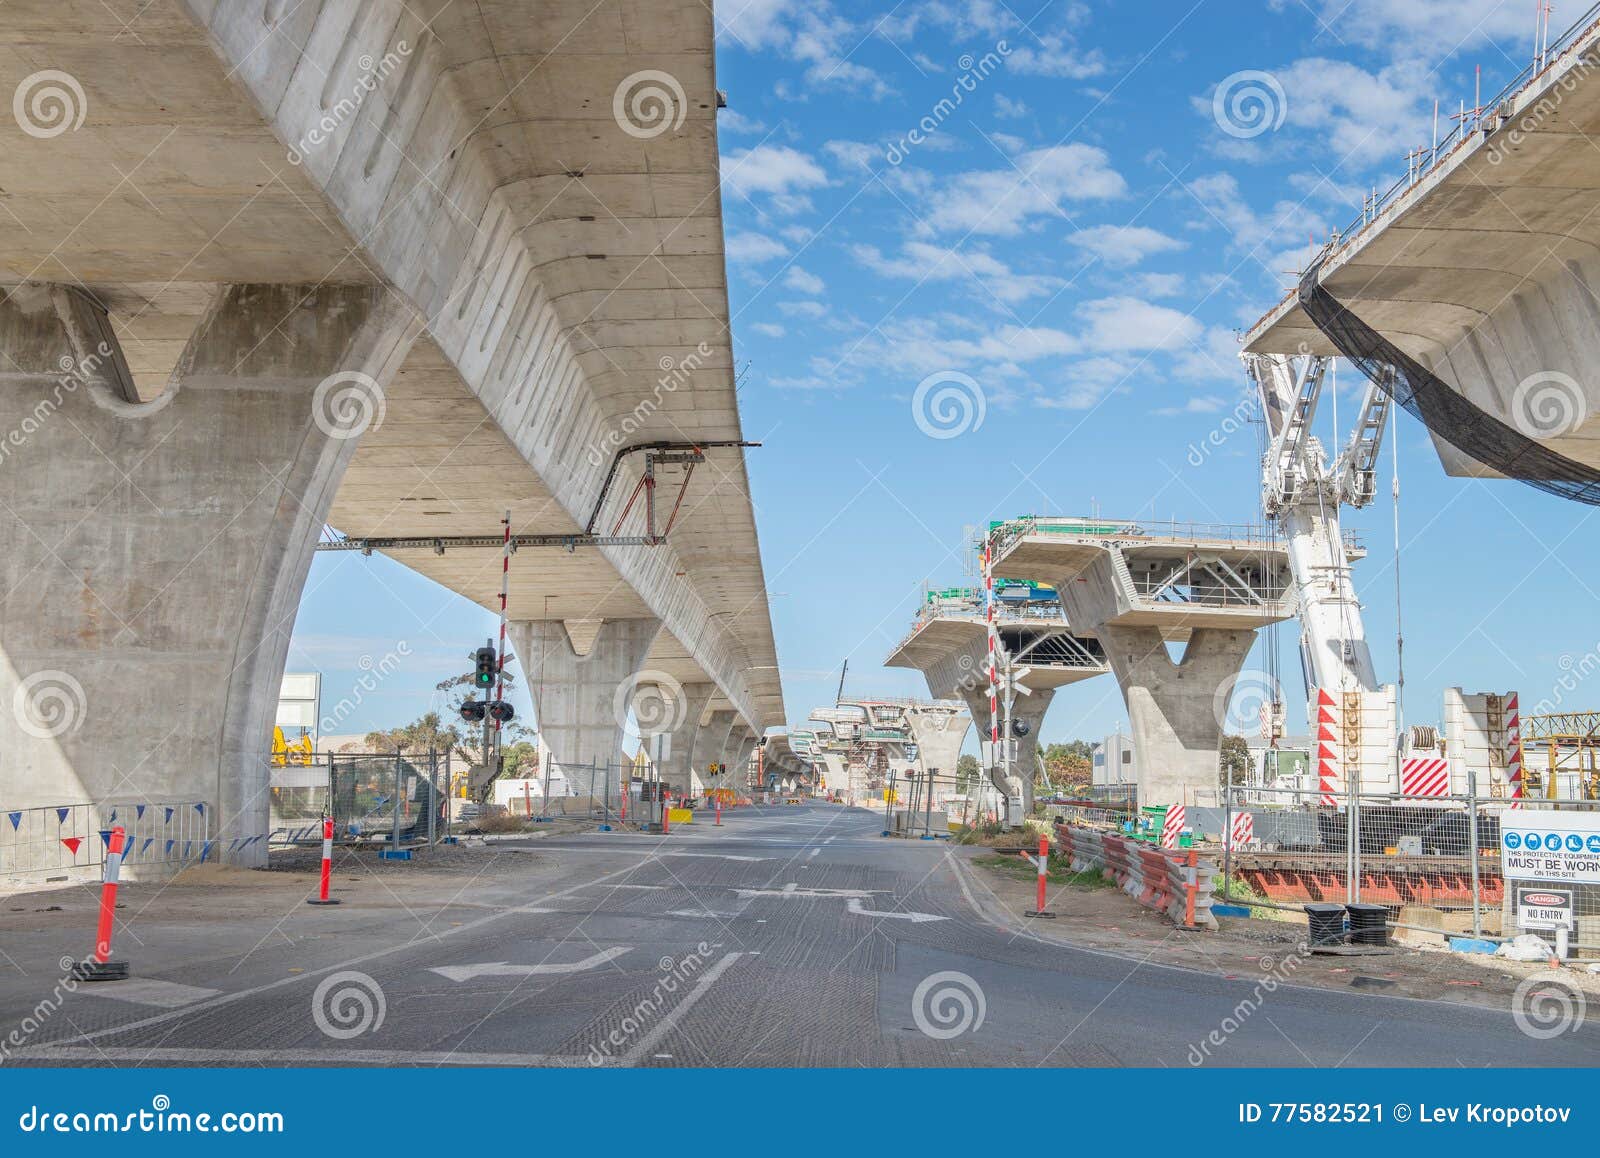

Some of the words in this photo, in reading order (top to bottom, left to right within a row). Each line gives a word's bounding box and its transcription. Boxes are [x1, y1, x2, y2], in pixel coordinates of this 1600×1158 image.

[1523, 851, 1563, 859] PROTECTIVE
[1508, 858, 1541, 869] MUST
[1545, 860, 1561, 870] BE
[1529, 895, 1560, 903] DANGER
[1527, 909, 1538, 919] NO
[1540, 910, 1563, 920] ENTRY
